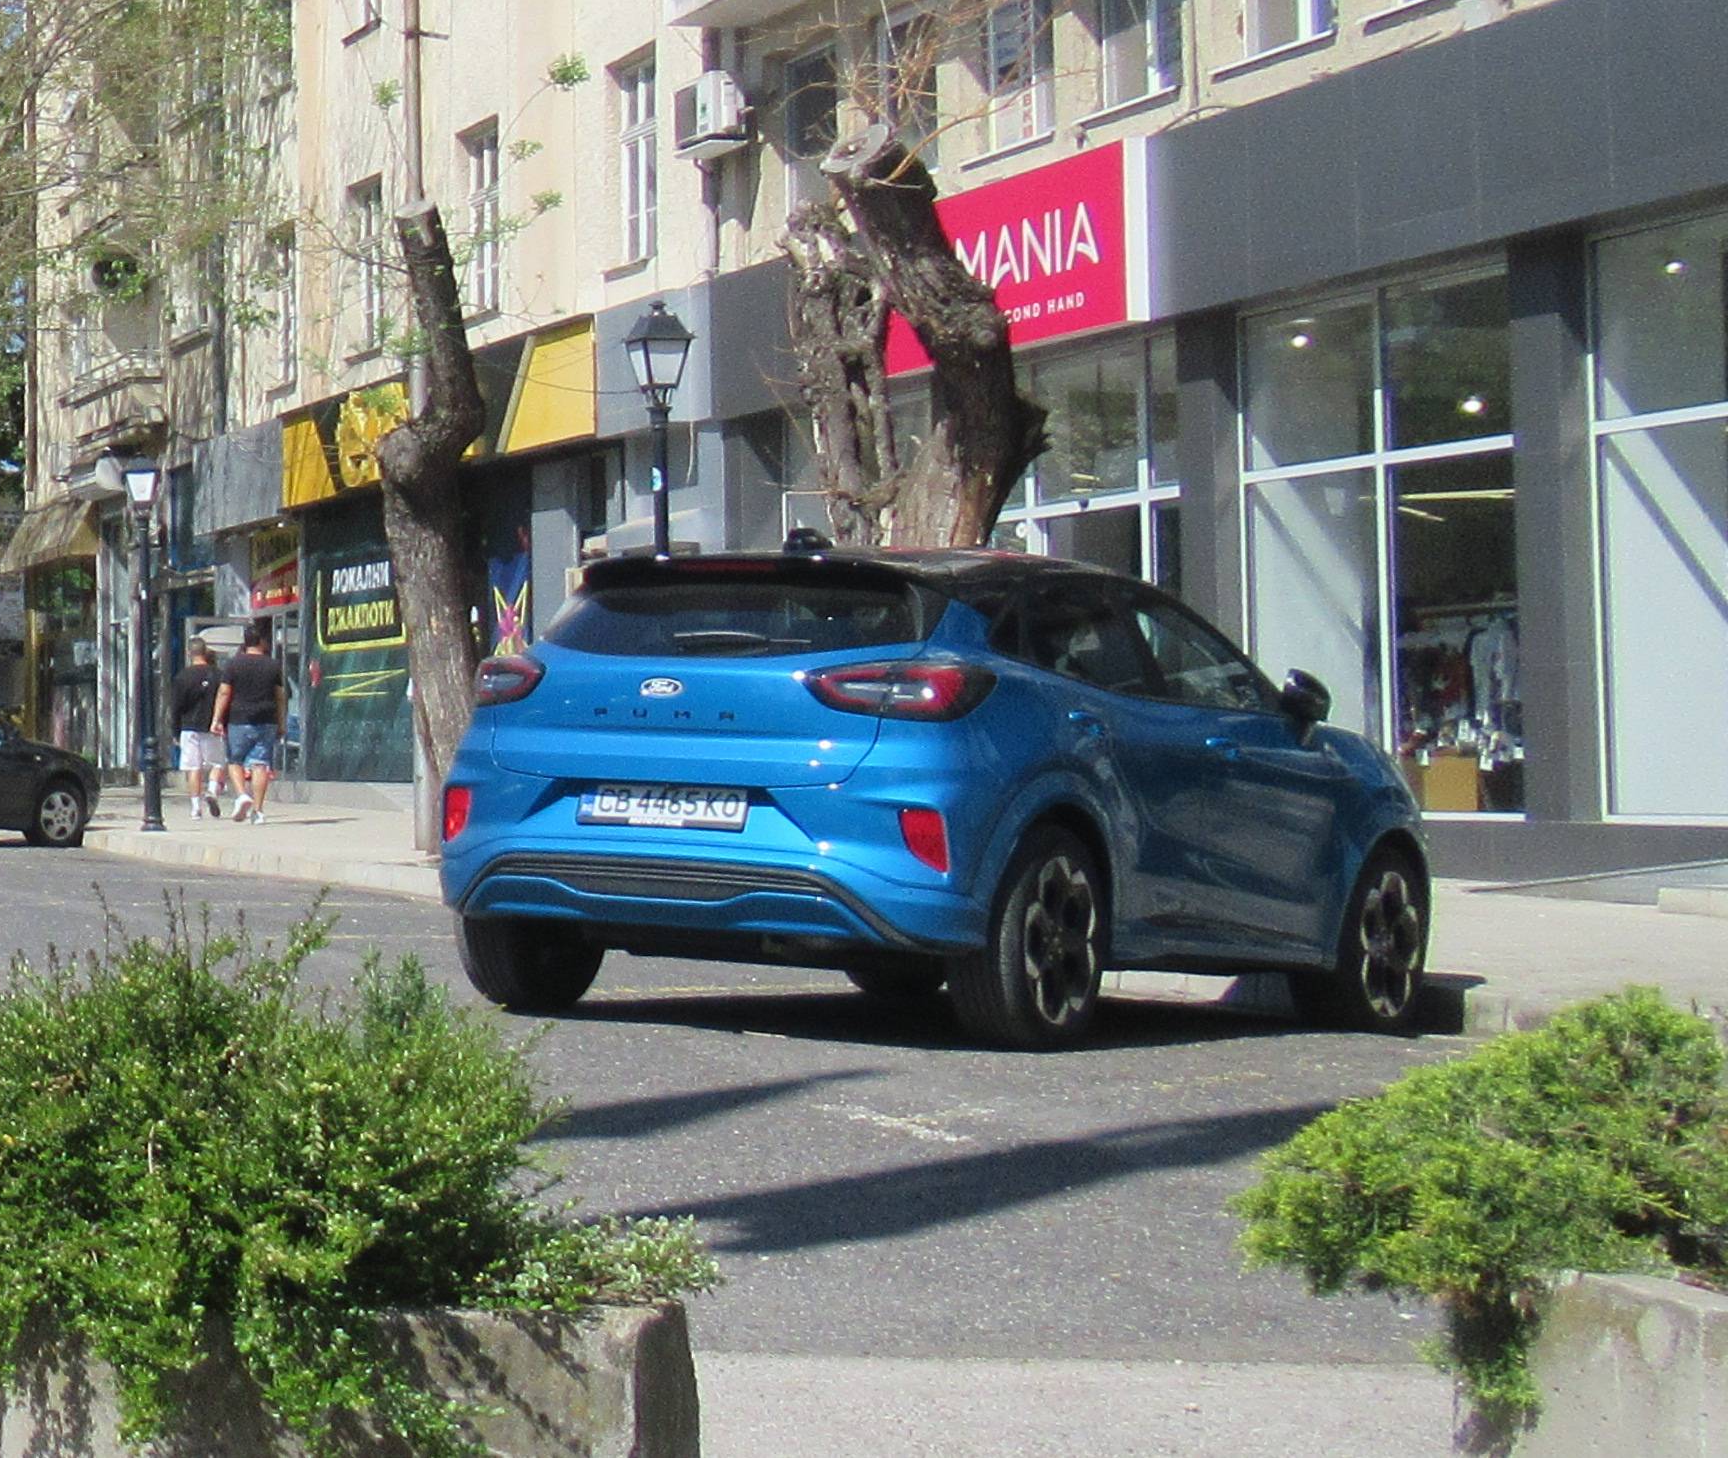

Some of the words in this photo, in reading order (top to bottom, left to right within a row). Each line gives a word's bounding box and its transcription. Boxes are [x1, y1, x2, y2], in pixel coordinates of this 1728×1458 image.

[955, 201, 1099, 289] MANIA
[1003, 303, 1042, 325] COND
[1047, 292, 1085, 313] HAND
